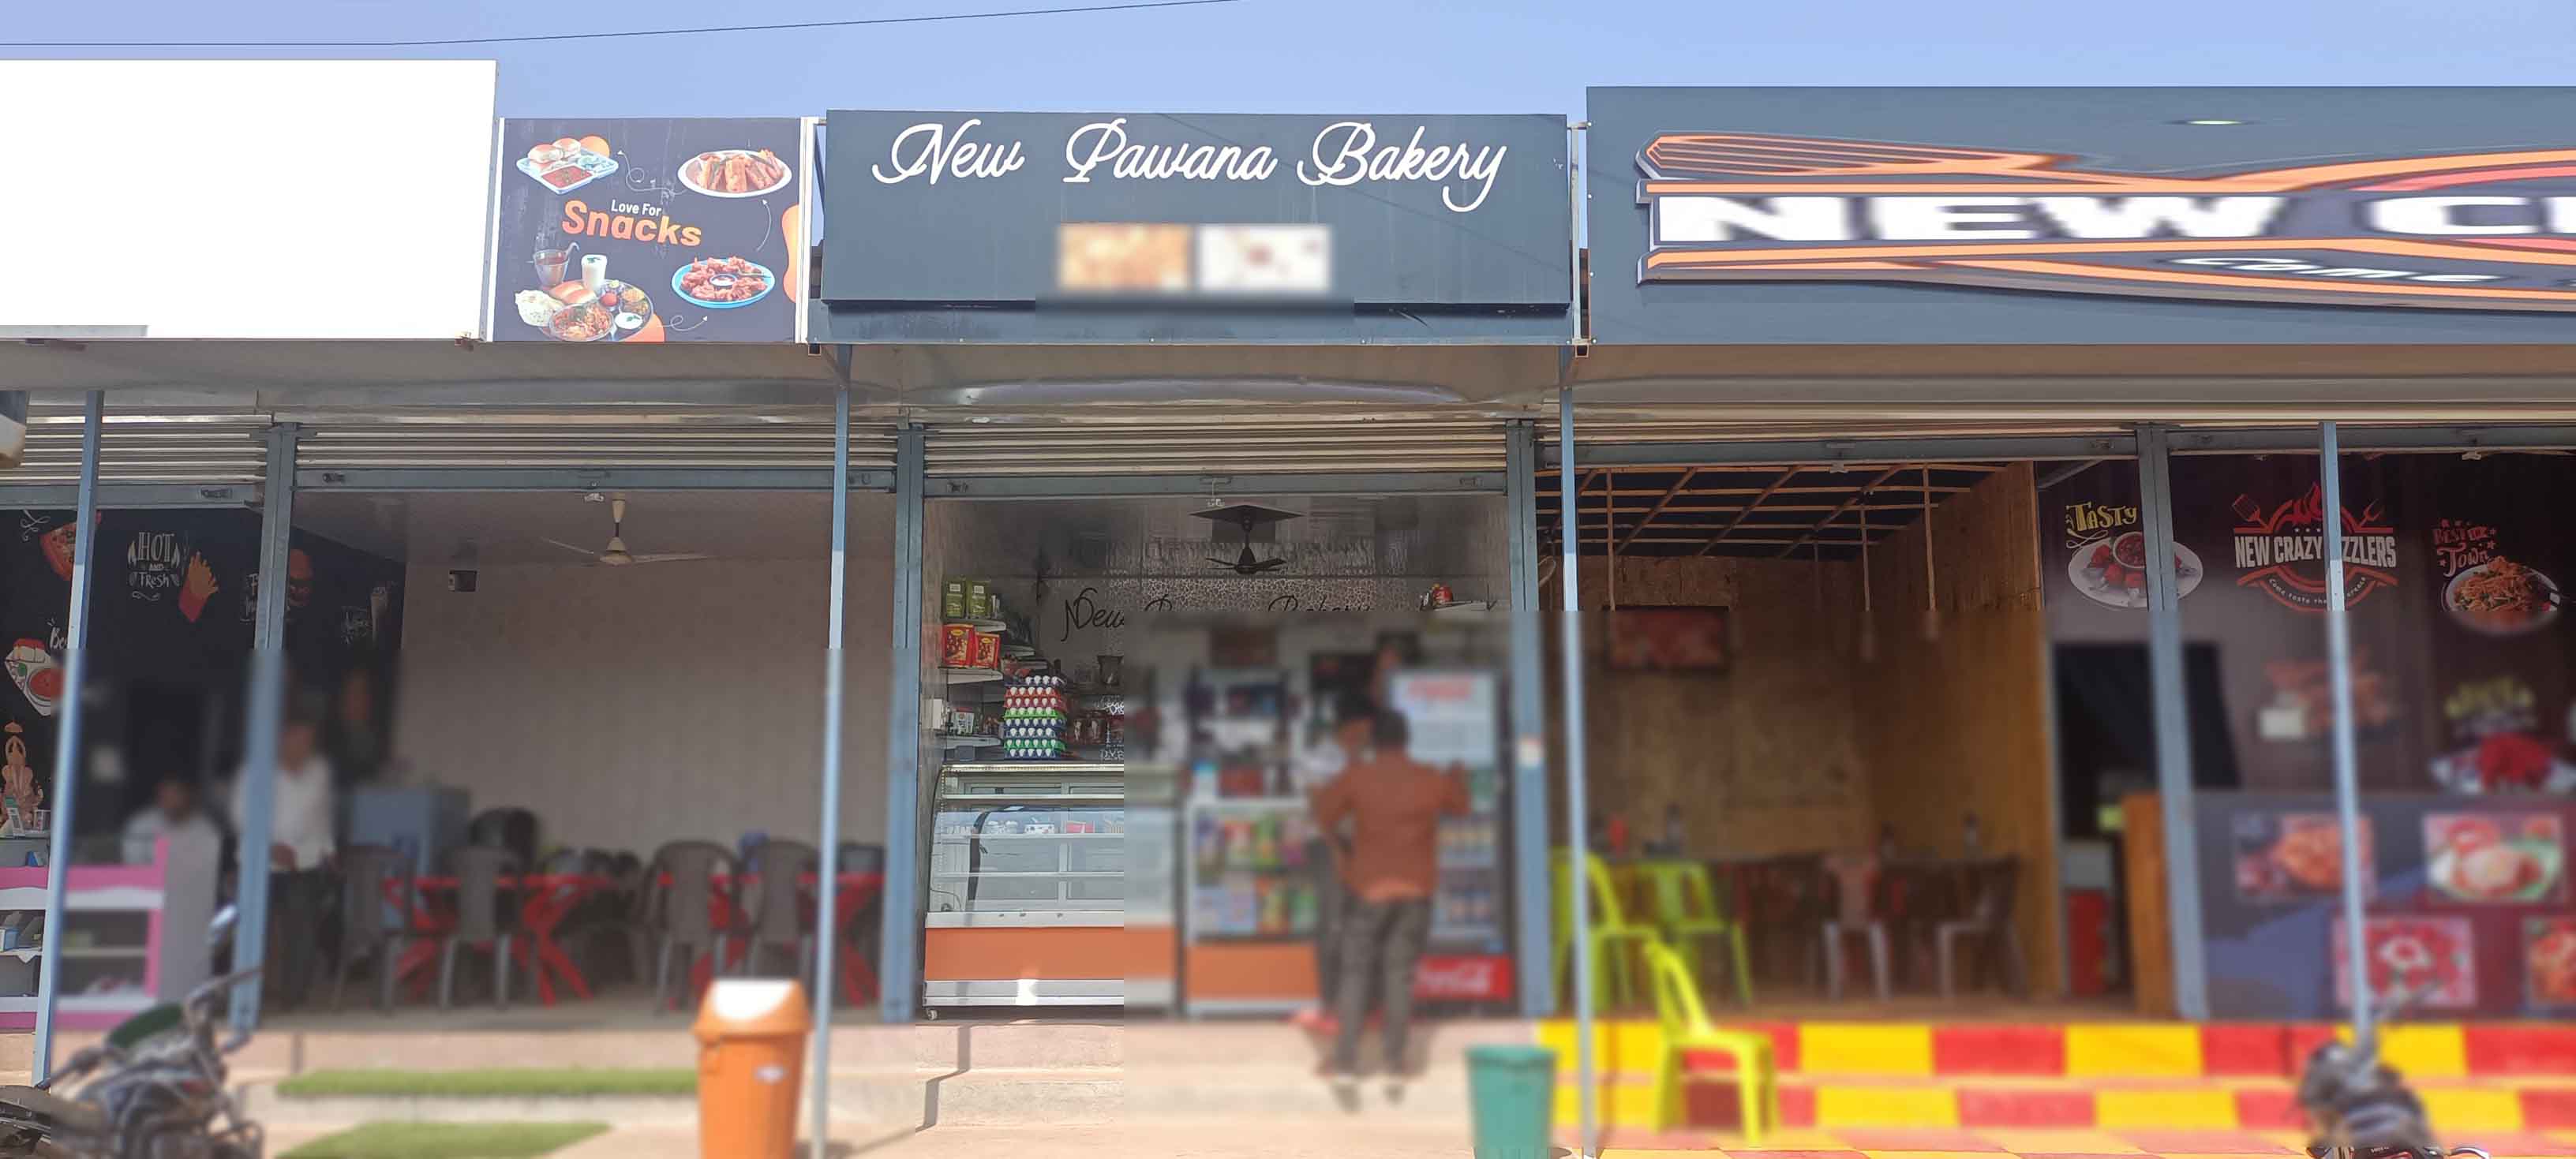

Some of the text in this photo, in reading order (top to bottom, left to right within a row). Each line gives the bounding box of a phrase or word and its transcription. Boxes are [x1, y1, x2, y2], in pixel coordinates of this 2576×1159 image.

[872, 118, 1507, 212] New Pawana Bakery
[562, 200, 702, 246] Snacks
[611, 200, 661, 216] Love For
[1660, 196, 2576, 242] NEW C
[2170, 257, 2503, 282] Come
[138, 532, 174, 561] HOT
[2234, 536, 2270, 568] NEW
[2274, 536, 2323, 563] CRAZY
